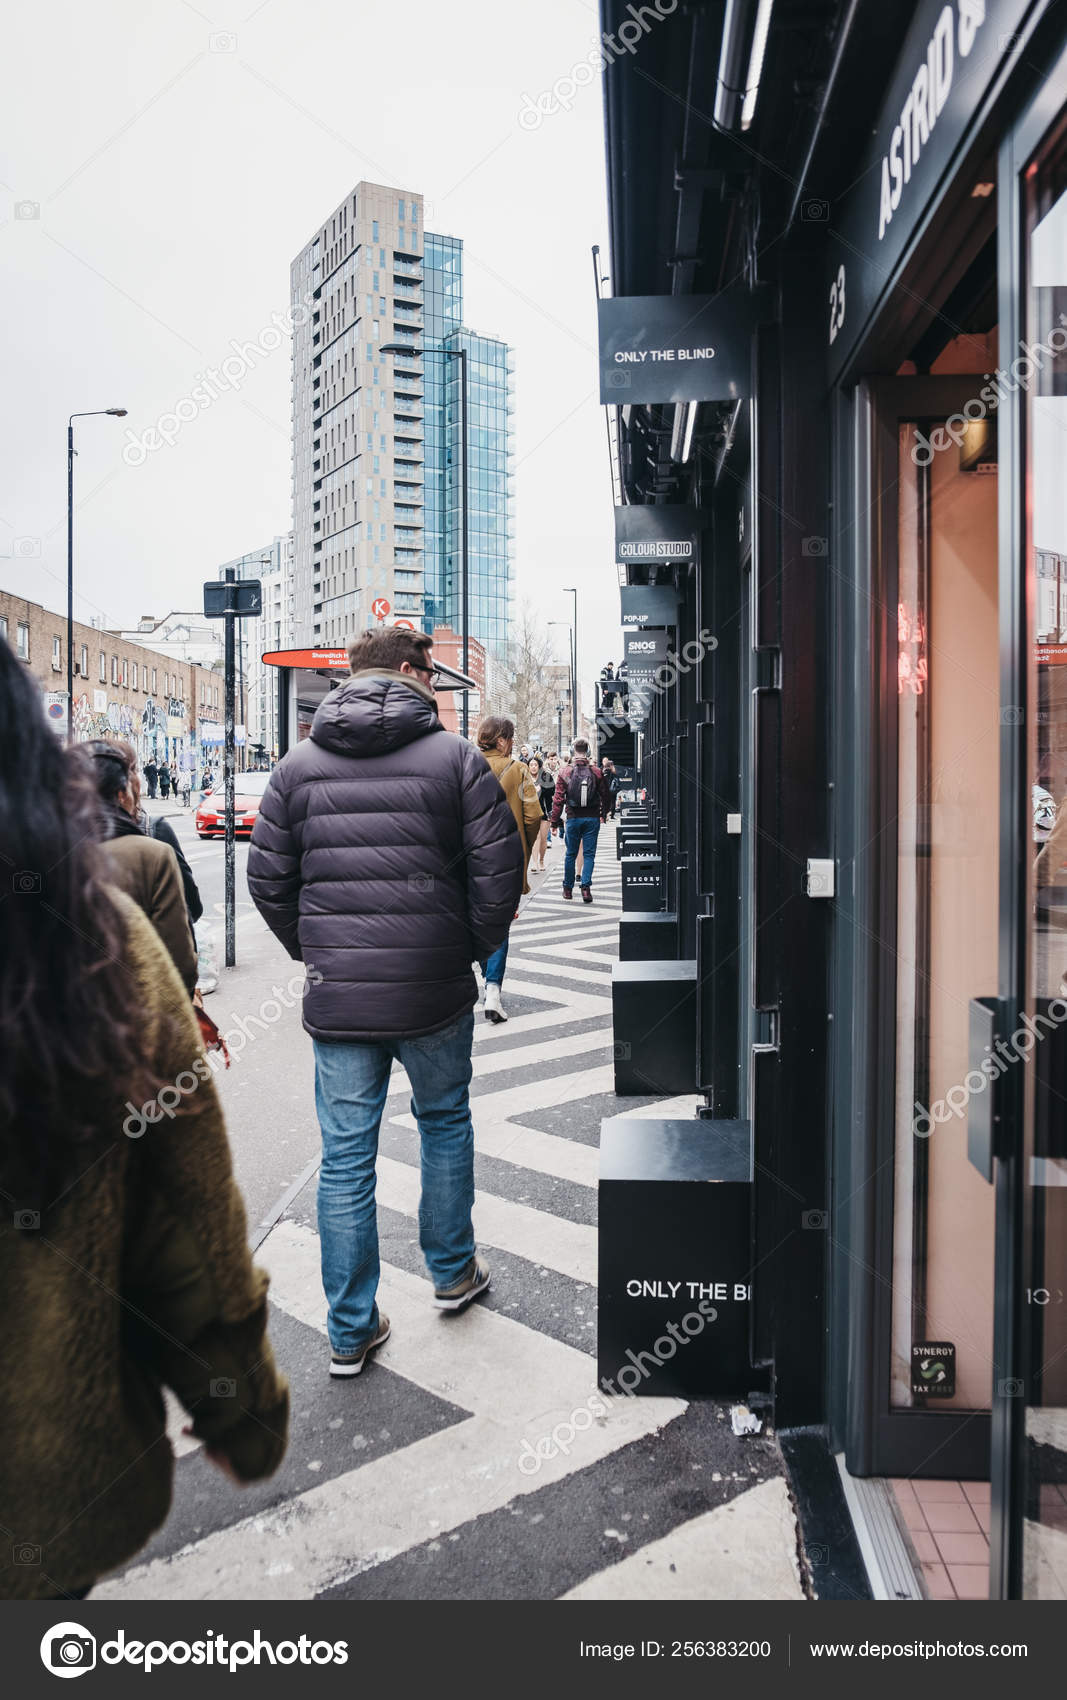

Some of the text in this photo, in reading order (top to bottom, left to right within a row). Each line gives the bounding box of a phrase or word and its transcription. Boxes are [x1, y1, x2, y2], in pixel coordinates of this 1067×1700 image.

[878, 4, 954, 241] ASTRID
[829, 264, 845, 345] 23
[614, 348, 715, 363] ONLY THE BLIND
[620, 542, 691, 555] COLOUR STUDIO
[374, 601, 386, 616] K
[628, 641, 656, 650] SNOG
[626, 1280, 681, 1298] ONLY
[686, 1282, 728, 1300] THE
[913, 1347, 954, 1356] SYNERGY
[913, 1385, 929, 1393] TAX
